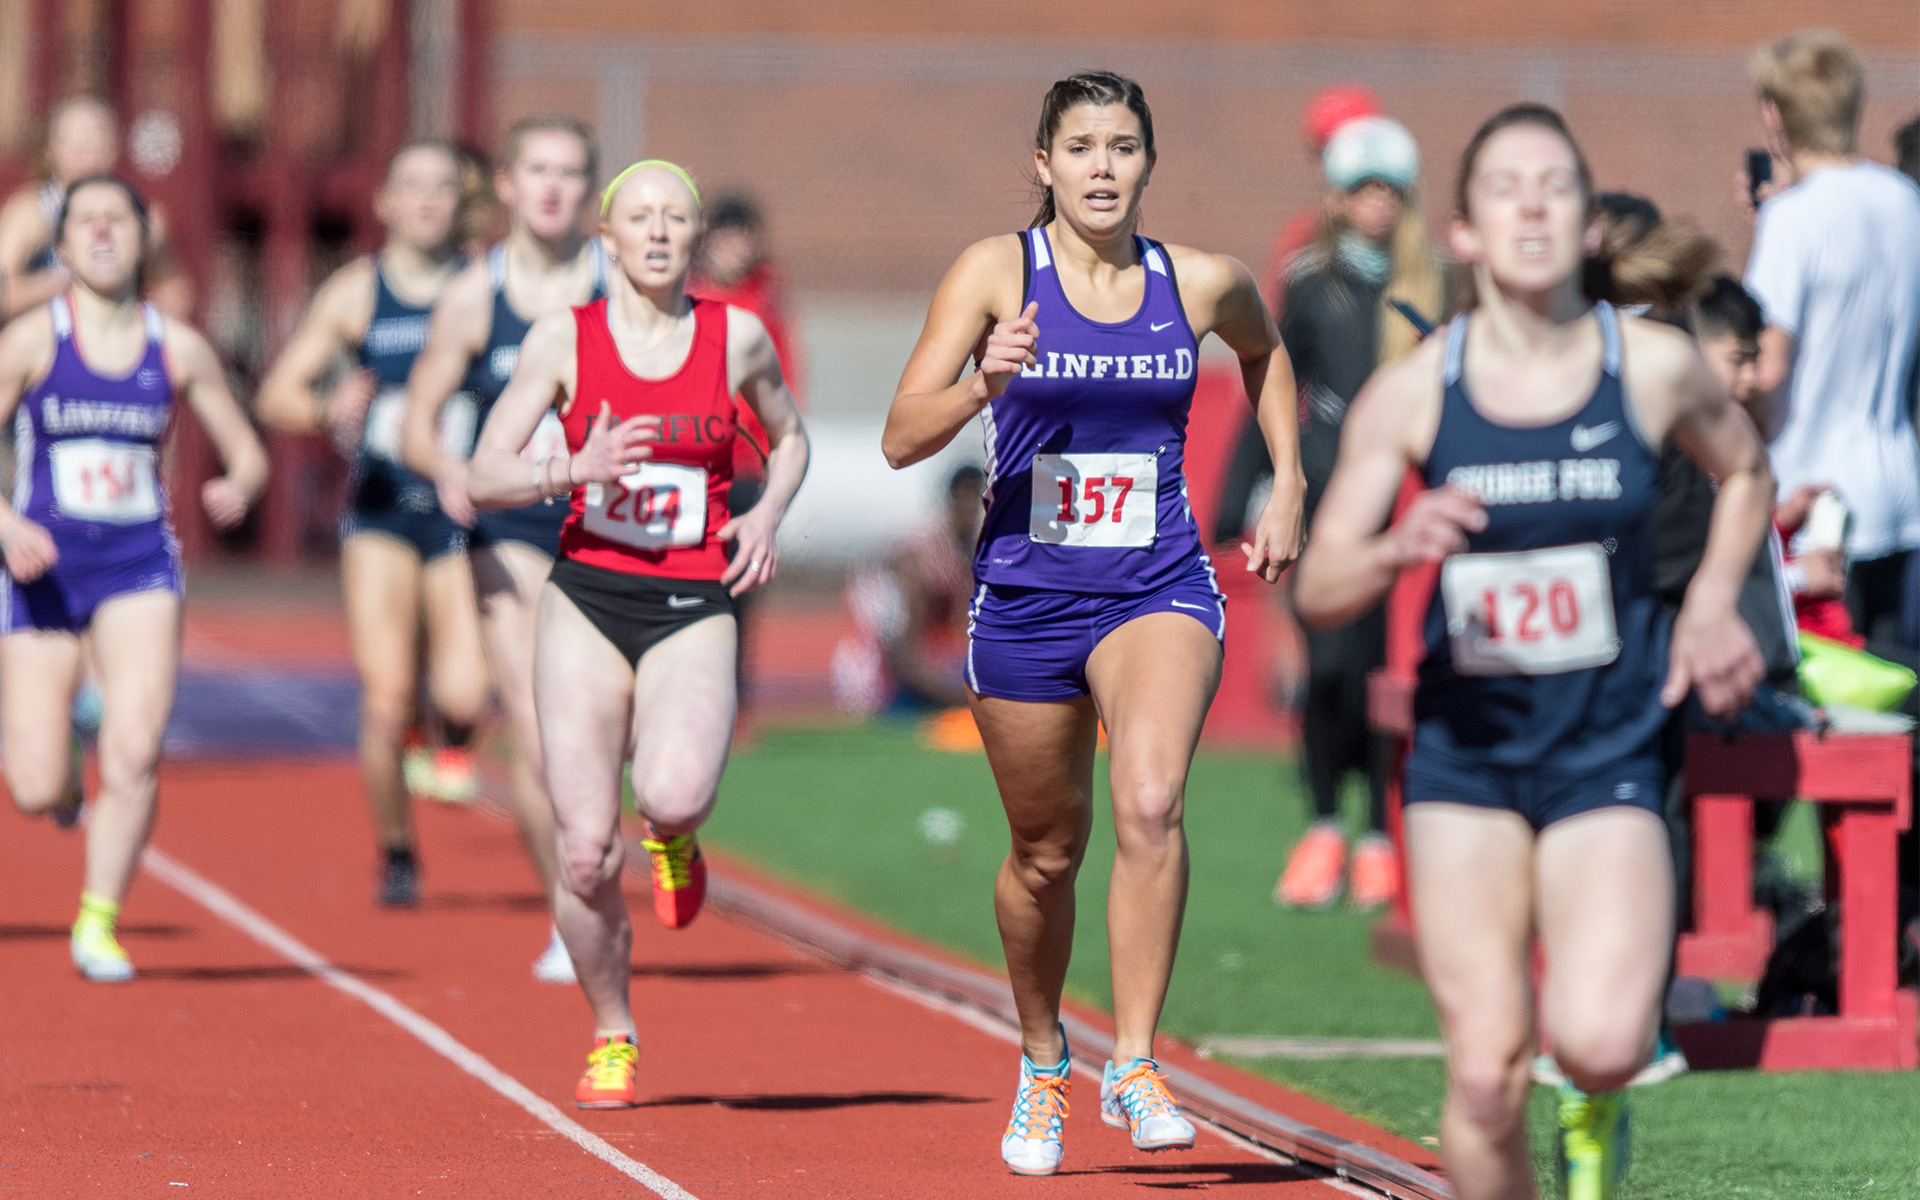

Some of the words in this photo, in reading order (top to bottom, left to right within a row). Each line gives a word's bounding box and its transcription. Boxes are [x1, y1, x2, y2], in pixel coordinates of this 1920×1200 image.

[1020, 348, 1193, 379] LINFIELD
[586, 414, 726, 443] PIFIC
[606, 478, 681, 530] 204
[1057, 477, 1133, 523] 157
[1481, 577, 1579, 644] 120
